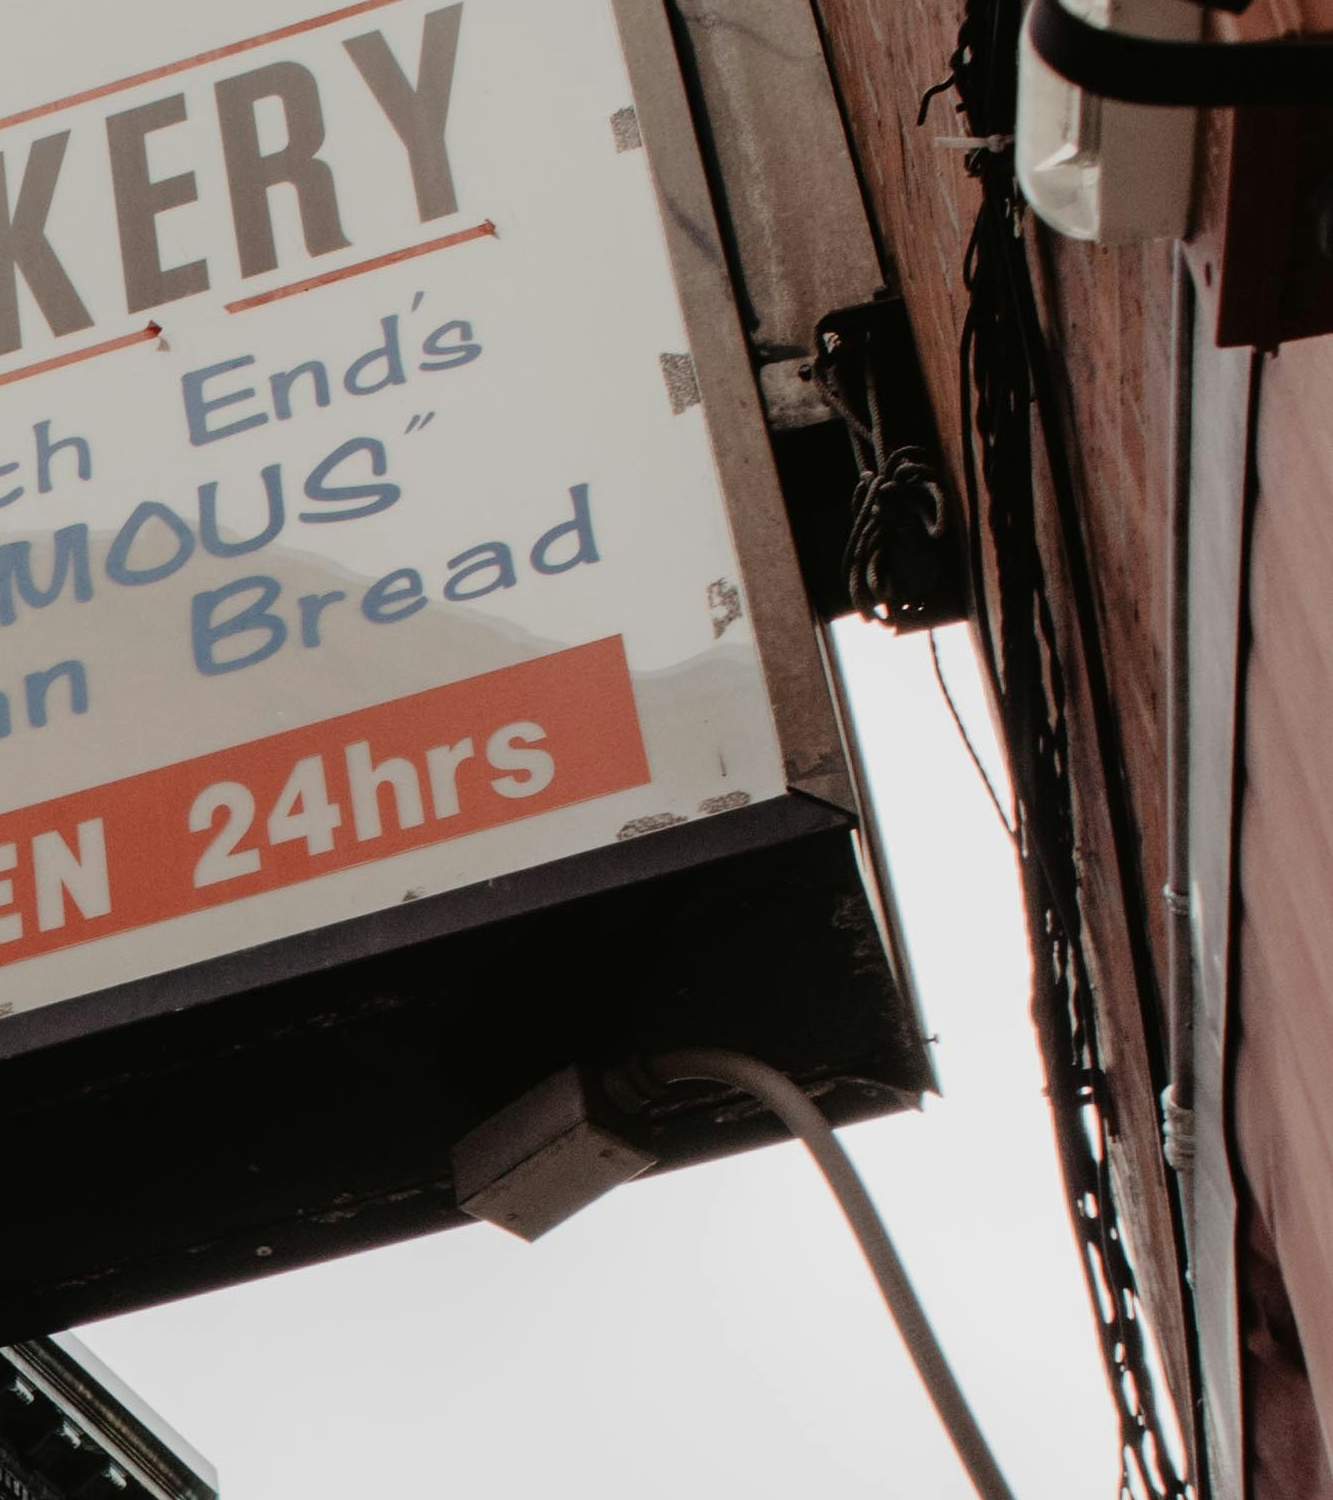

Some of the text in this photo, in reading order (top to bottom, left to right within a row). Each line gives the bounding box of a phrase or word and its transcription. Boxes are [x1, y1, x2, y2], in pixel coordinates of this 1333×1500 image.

[181, 290, 483, 446] End's
[190, 481, 602, 677] Bread
[187, 719, 557, 889] 24hrs
